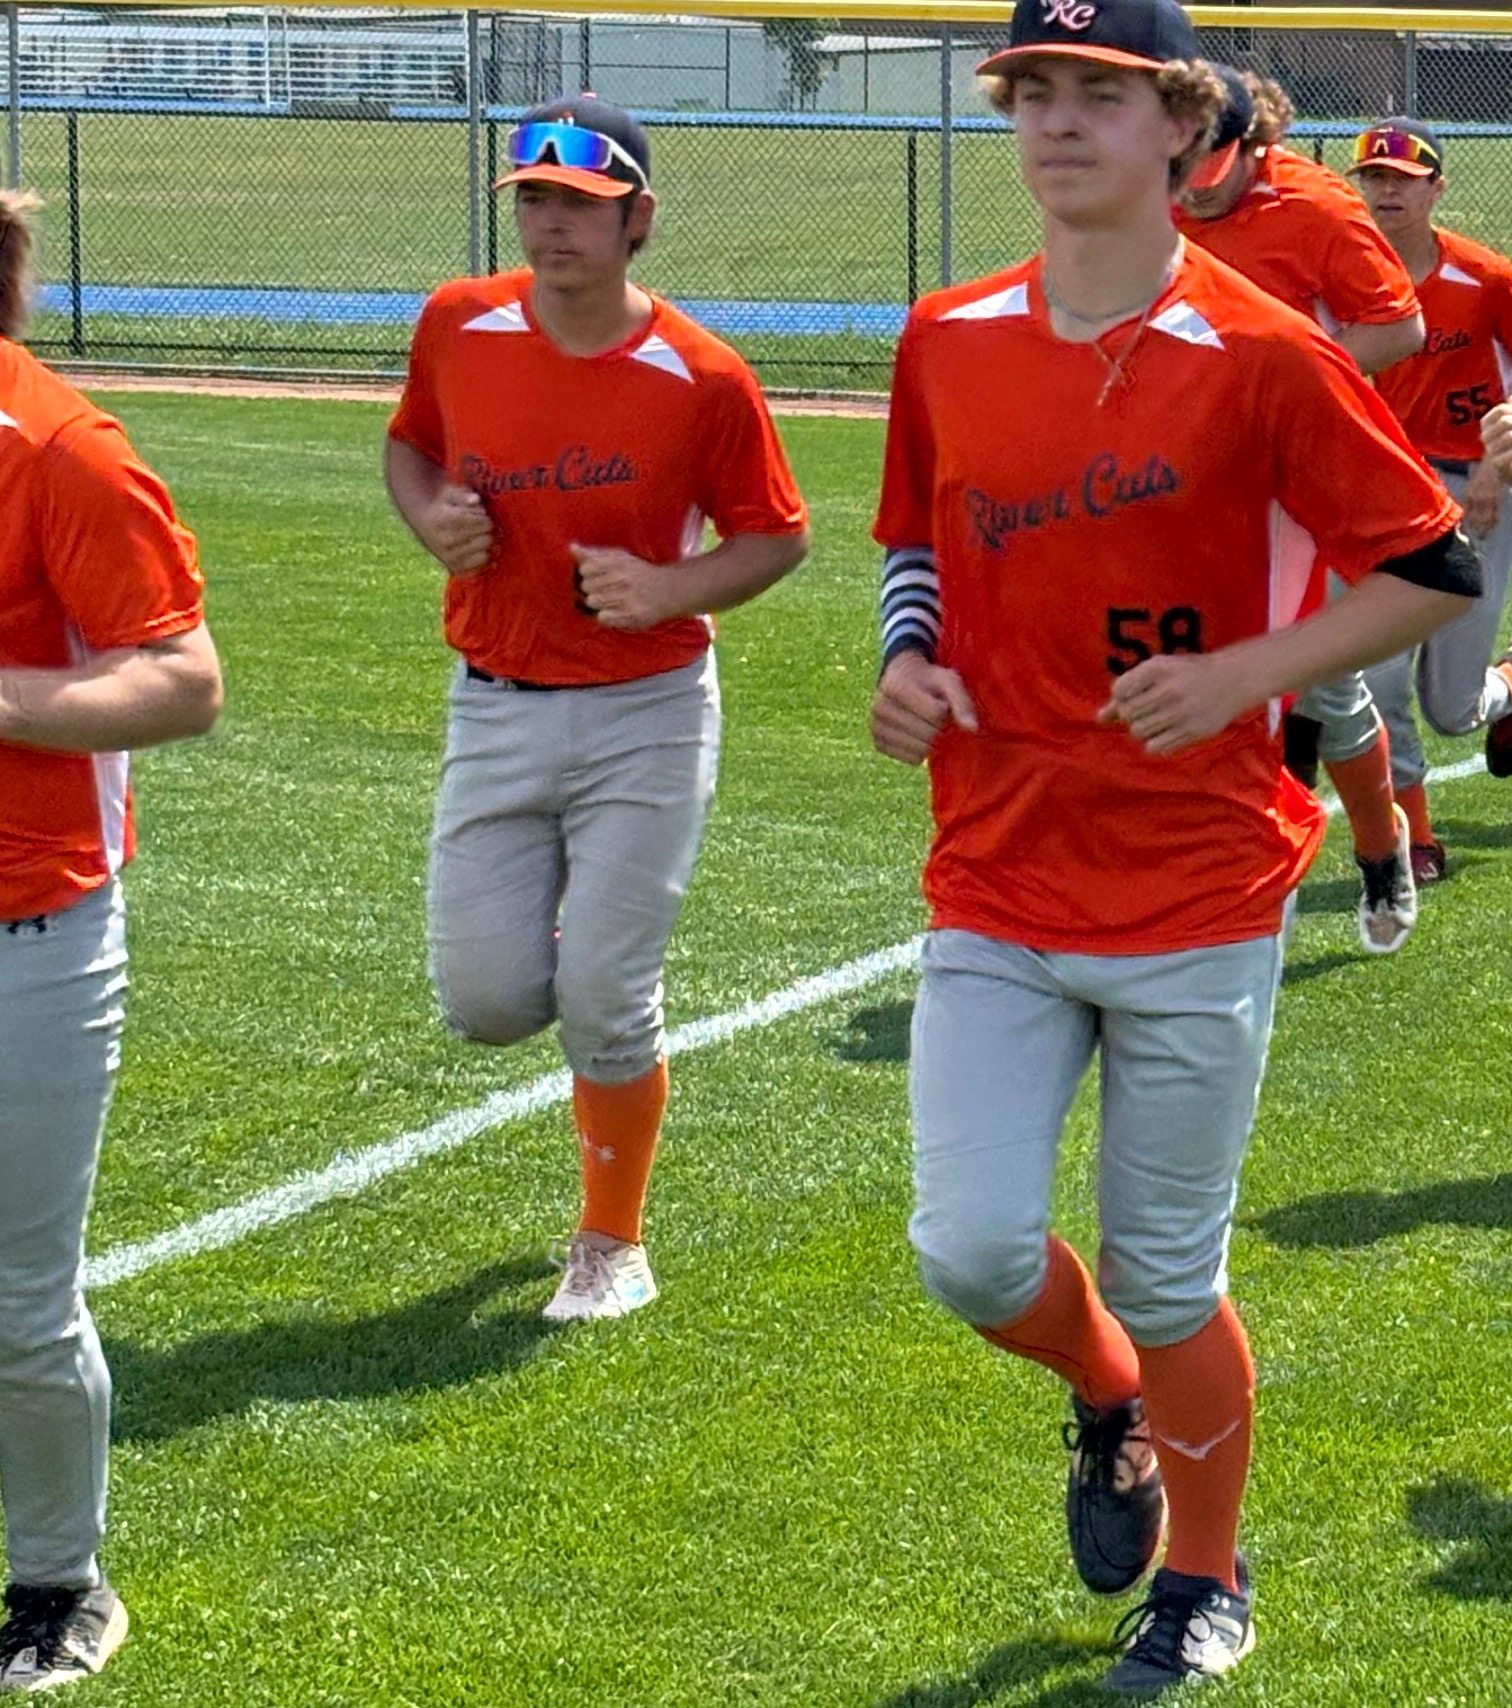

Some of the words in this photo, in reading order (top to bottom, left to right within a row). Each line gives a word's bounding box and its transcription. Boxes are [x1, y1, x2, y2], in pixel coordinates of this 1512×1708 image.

[555, 444, 635, 491] Cats
[965, 489, 1067, 549] River
[1081, 452, 1181, 518] Cats
[1105, 605, 1202, 677] 58
